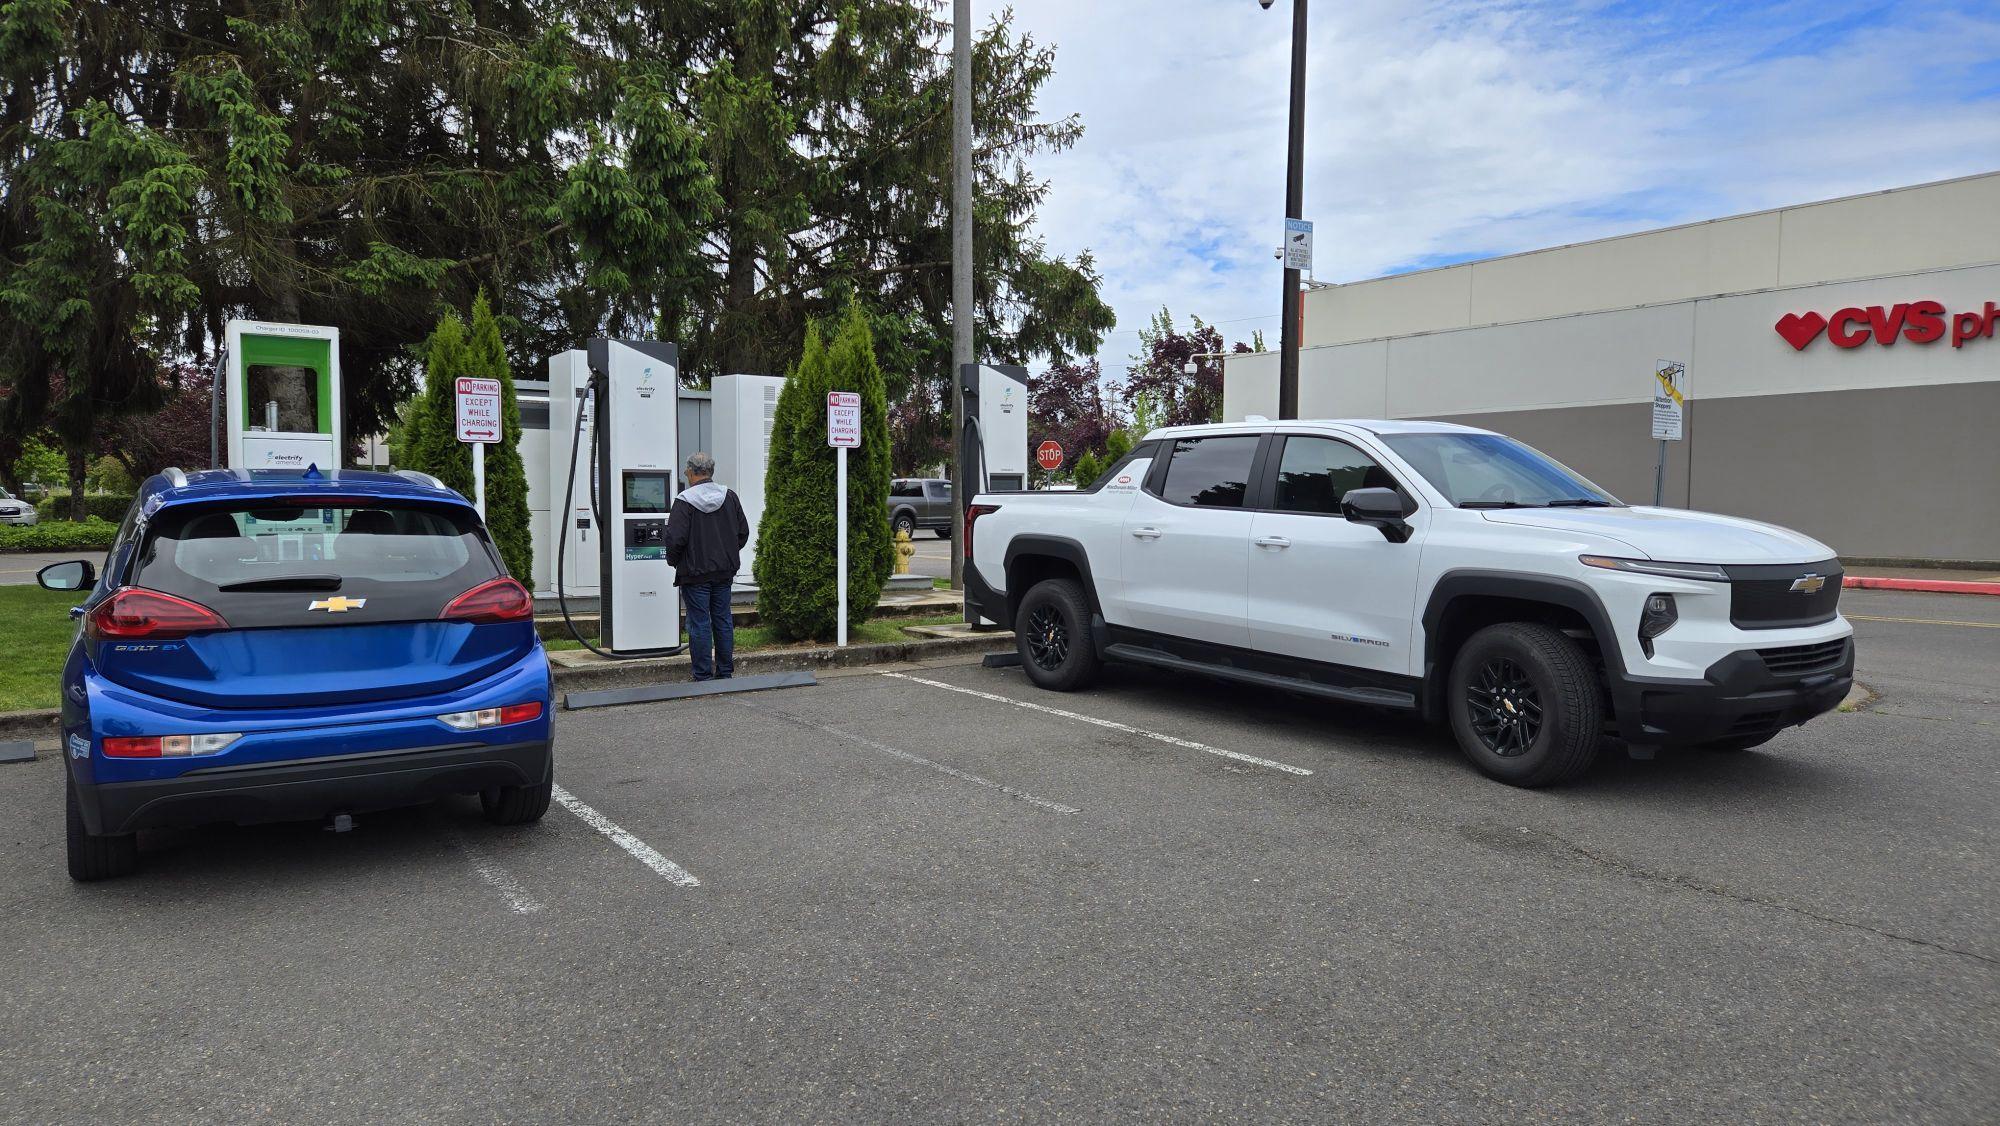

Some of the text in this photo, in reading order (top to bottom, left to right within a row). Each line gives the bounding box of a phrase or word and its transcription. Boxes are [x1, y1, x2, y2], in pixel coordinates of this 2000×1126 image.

[1287, 221, 1312, 232] NOTICE
[1828, 300, 1946, 348] CVS
[460, 381, 497, 392] NO PARKING
[465, 398, 492, 406] EXCEPT
[830, 395, 838, 405] NO
[468, 409, 490, 417] WHILE
[461, 418, 497, 427] CHARGING
[1039, 449, 1060, 460] STOP
[1331, 634, 1390, 647] SILVERADO
